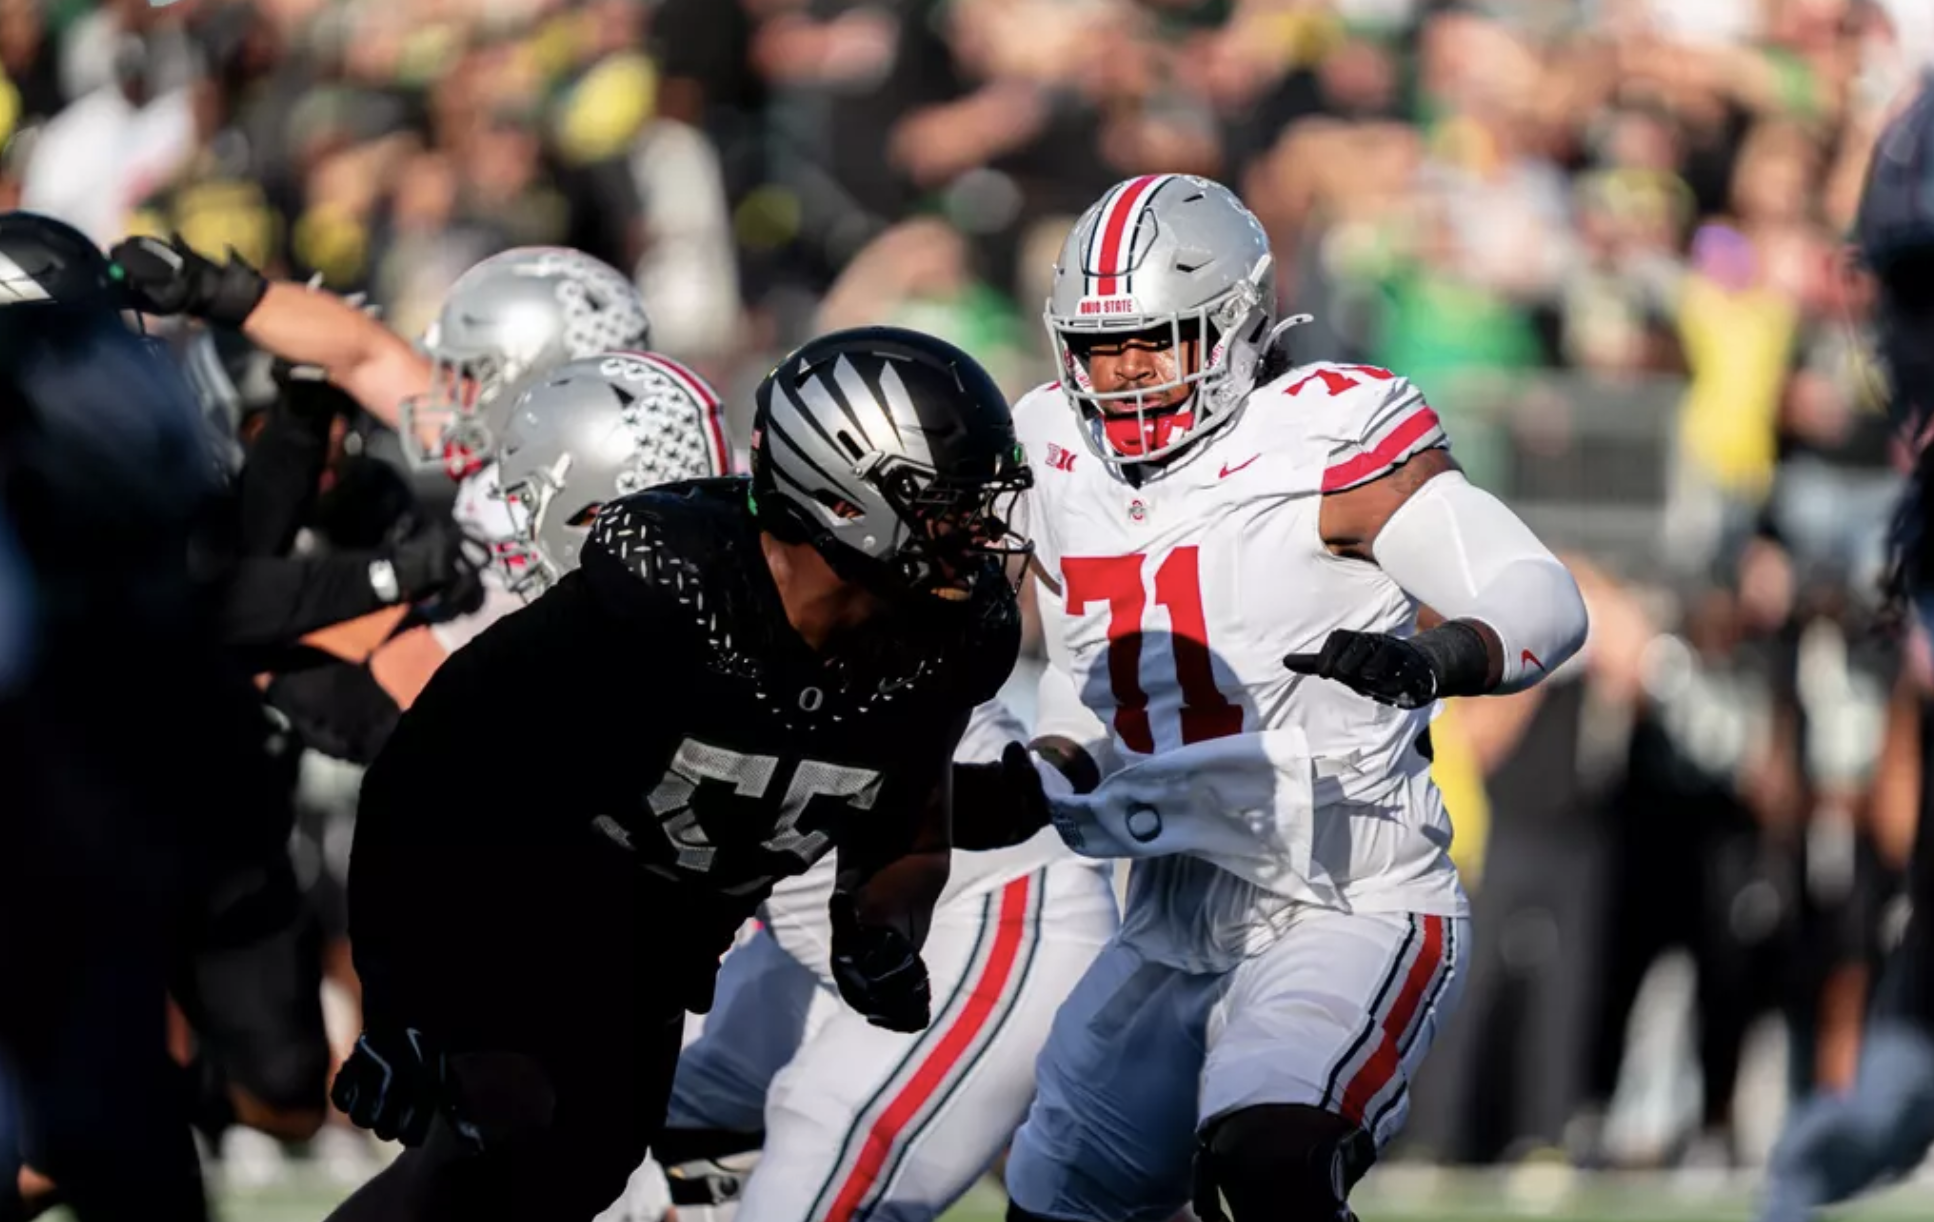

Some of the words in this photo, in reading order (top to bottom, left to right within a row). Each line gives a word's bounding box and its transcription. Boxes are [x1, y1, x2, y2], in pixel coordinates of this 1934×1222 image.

[1081, 301, 1101, 314] OHIO
[1104, 299, 1132, 313] STATE
[1060, 545, 1243, 754] 71
[799, 687, 823, 711] O
[592, 737, 884, 872] 55
